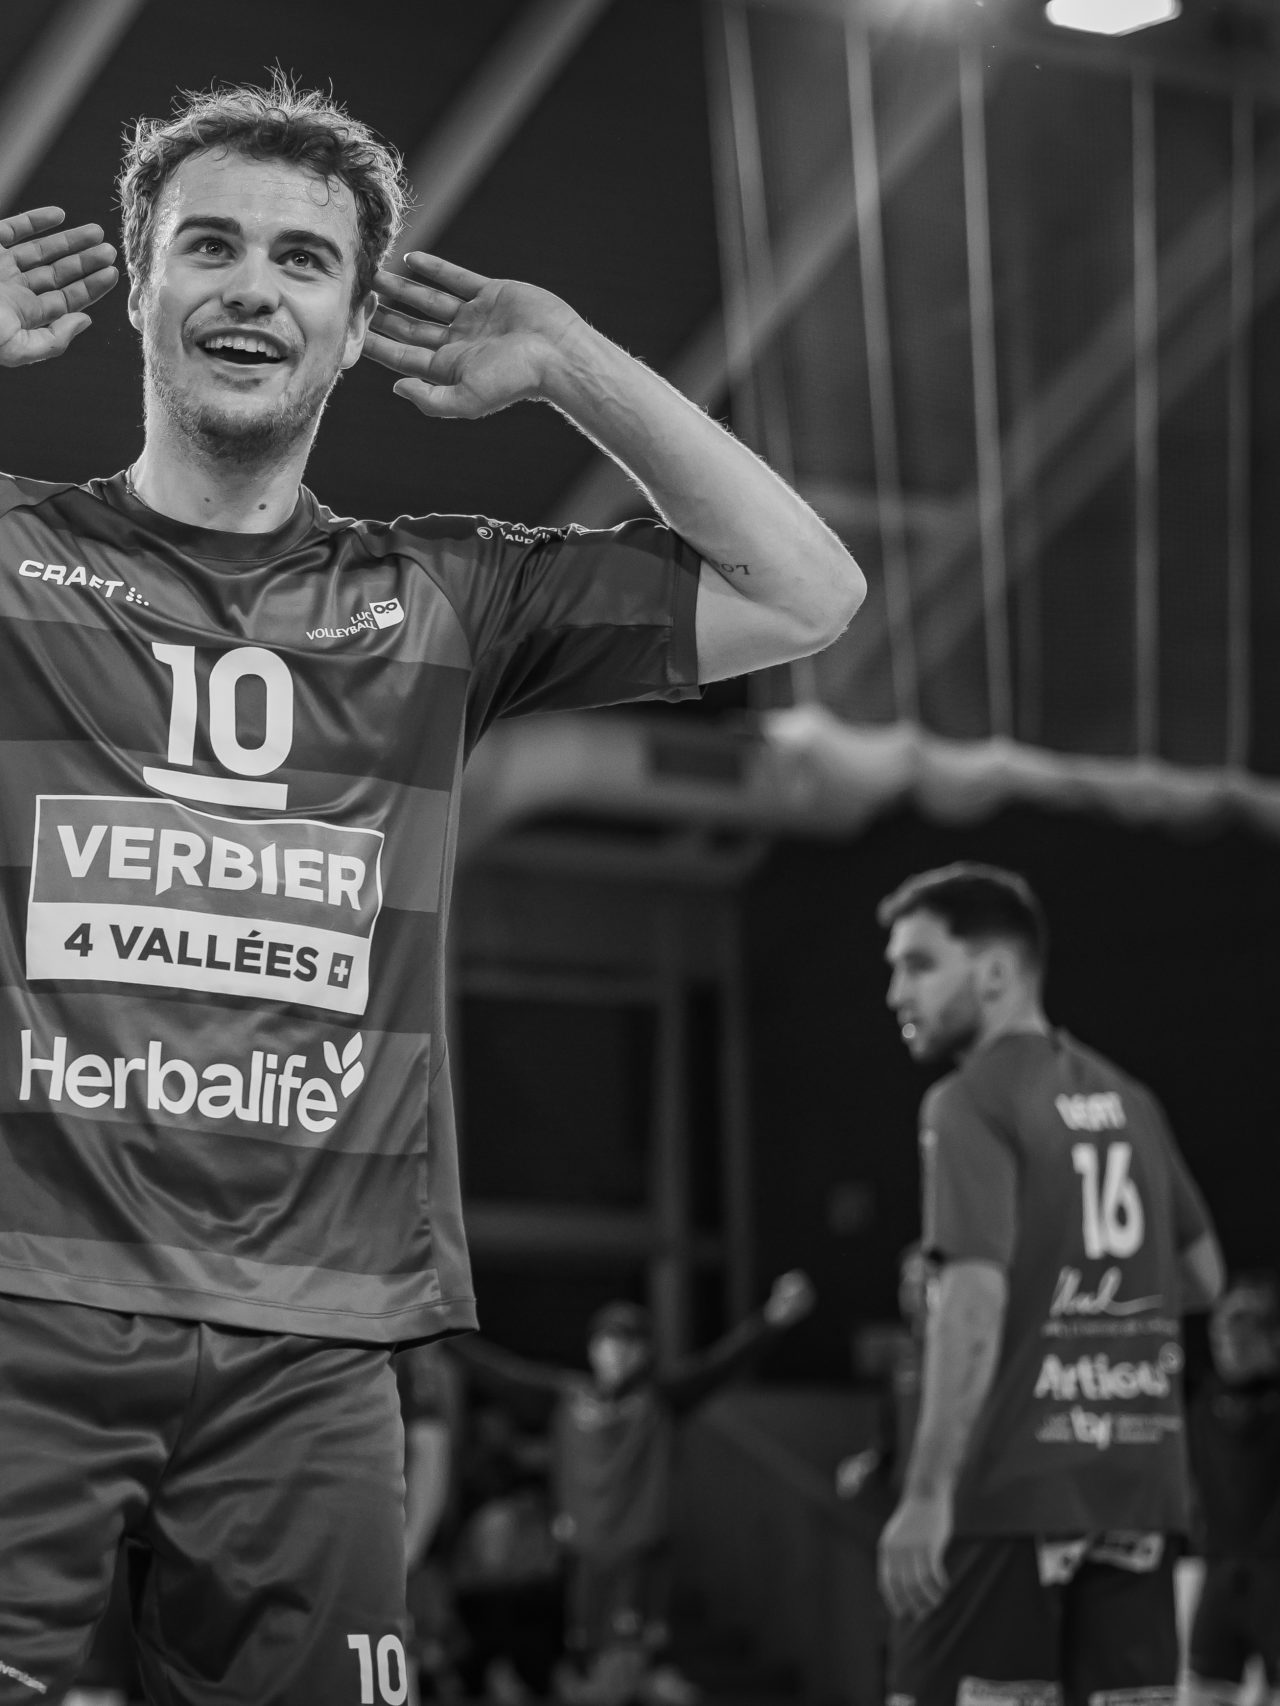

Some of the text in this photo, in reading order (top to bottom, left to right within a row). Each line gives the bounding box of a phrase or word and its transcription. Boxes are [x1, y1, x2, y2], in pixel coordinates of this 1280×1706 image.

[19, 560, 124, 598] CRAFT
[306, 621, 378, 640] VOLLEYBALL
[350, 611, 375, 624] LUC
[152, 642, 293, 776] 10
[57, 825, 367, 911] VERBIER
[64, 923, 319, 982] 4 VALLÉES
[19, 1029, 338, 1133] Herbalife
[1071, 1142, 1146, 1260] 16
[347, 1634, 408, 1706] 10
